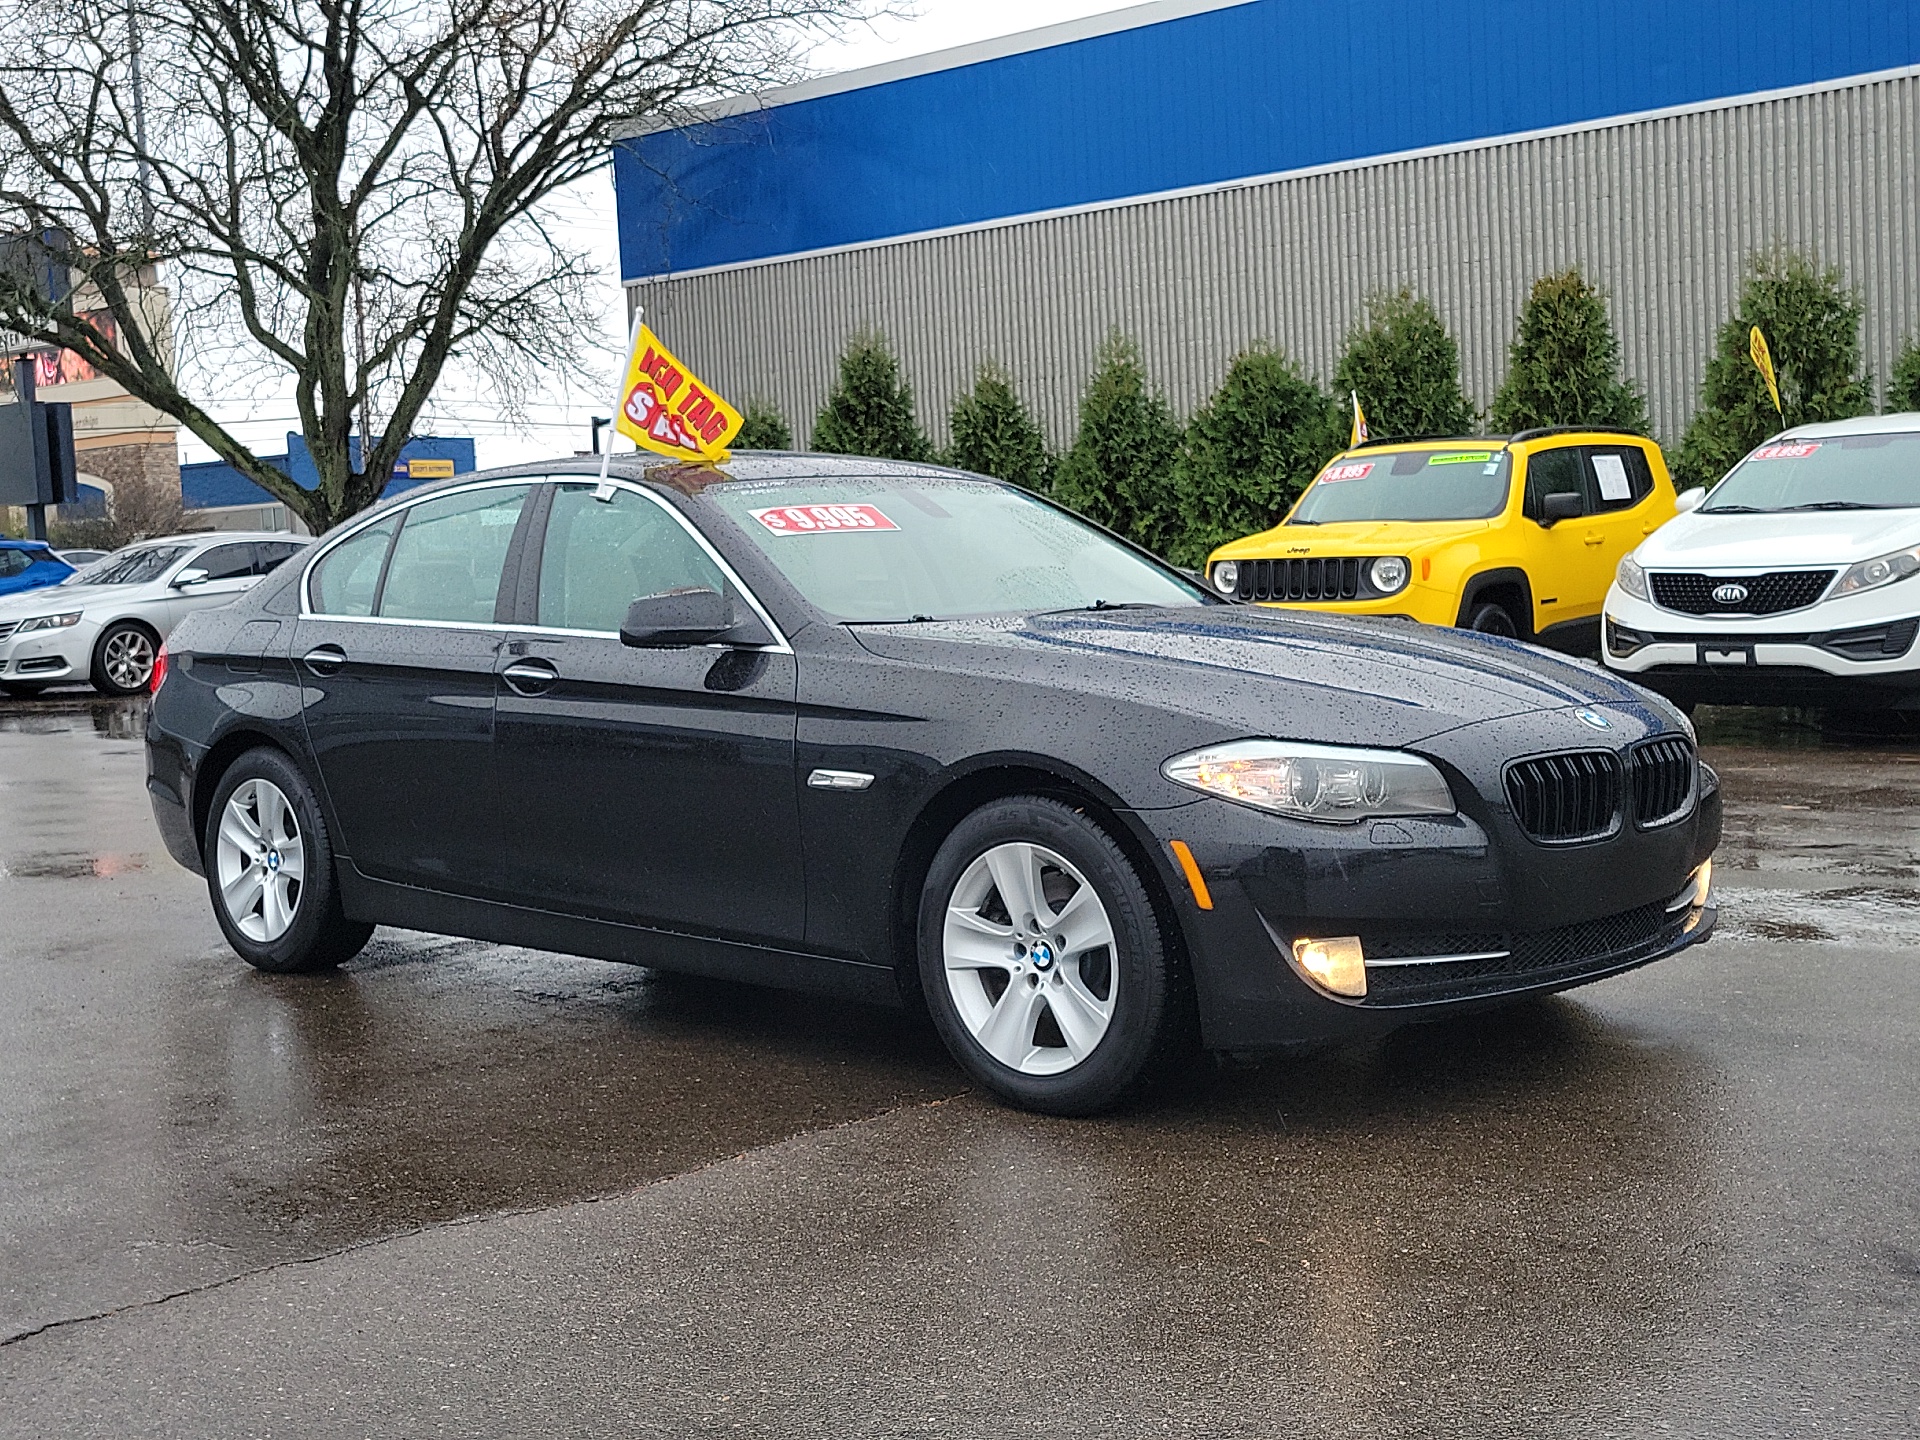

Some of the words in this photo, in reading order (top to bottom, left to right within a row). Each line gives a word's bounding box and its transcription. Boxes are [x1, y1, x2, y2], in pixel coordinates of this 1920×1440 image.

[627, 391, 697, 450] SAL
[677, 383, 729, 445] TAG
[1717, 588, 1741, 600] KIA
